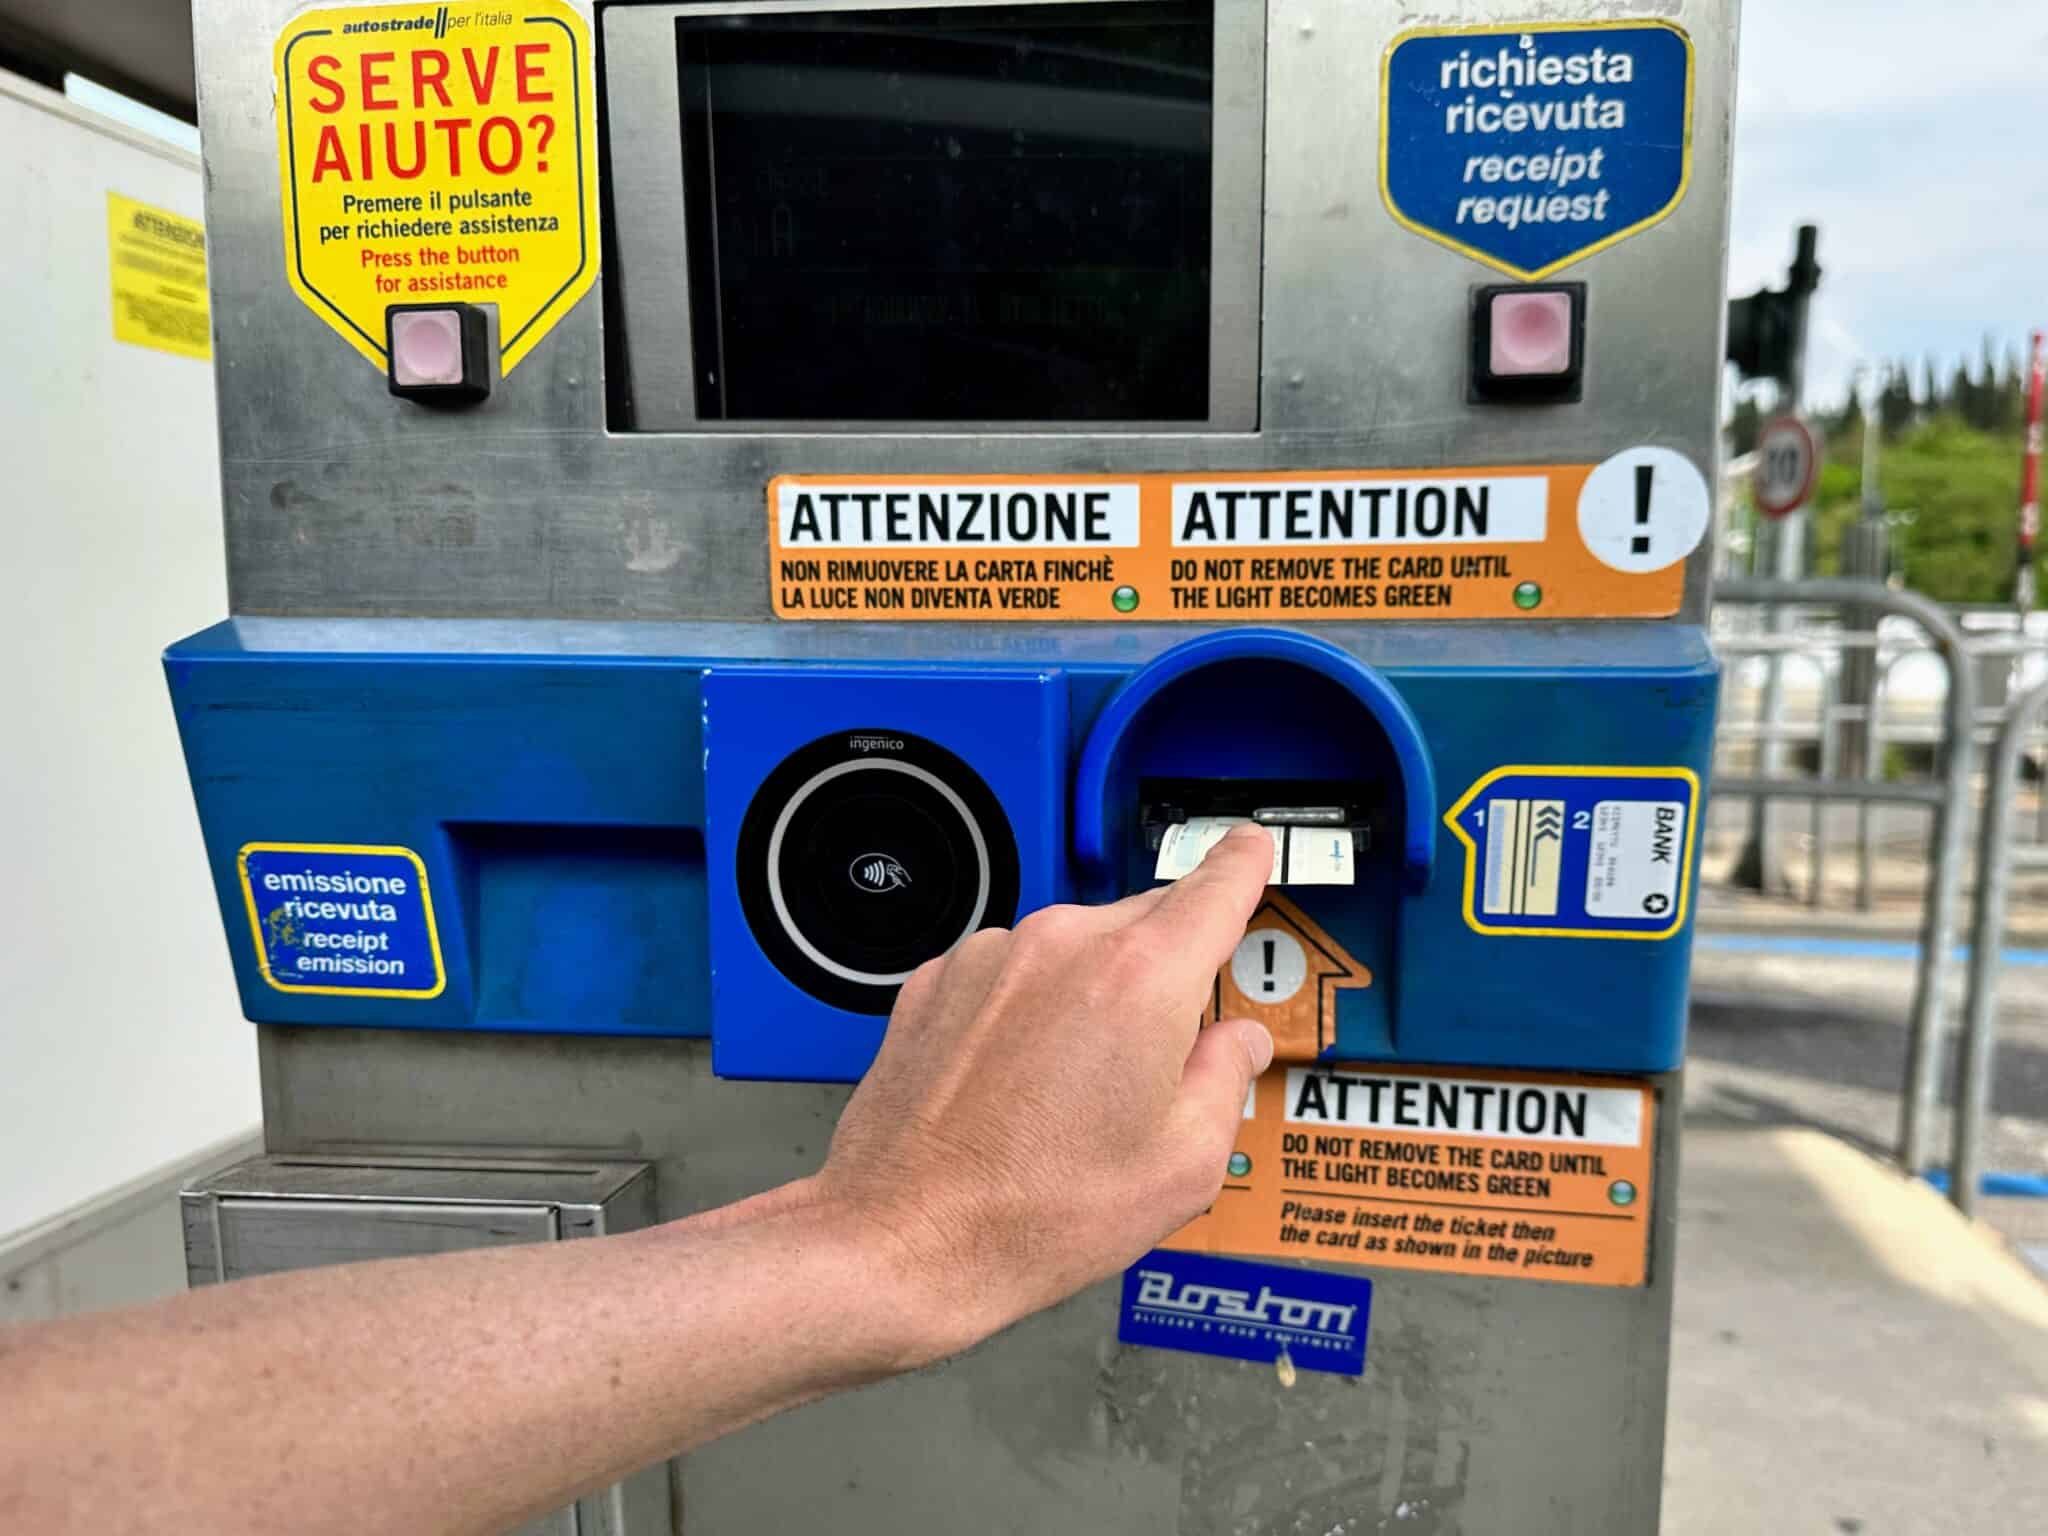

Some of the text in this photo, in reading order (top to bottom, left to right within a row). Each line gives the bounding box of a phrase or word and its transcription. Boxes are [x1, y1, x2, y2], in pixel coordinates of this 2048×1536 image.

[343, 16, 434, 34] autostrade
[447, 14, 471, 32] per
[308, 43, 554, 114] SERVE
[1440, 48, 1633, 88] richiesta
[1446, 94, 1625, 134] ricevuta
[312, 115, 555, 183] AIUTO?
[1463, 147, 1604, 187] receipt
[343, 188, 532, 214] Premere il pulsante
[1455, 189, 1610, 230] request
[320, 215, 558, 244] per richiedere assistenza
[361, 246, 520, 268] Press the button
[376, 271, 507, 293] for assistance
[790, 492, 1111, 541] ATTENZIONE
[1182, 485, 1490, 541] ATTENTION
[1631, 466, 1654, 554] !
[781, 555, 1114, 582] NON RIMUOVERE LA CARTA FINCHÈ
[1171, 555, 1512, 581] DO NOT REMOVE THE CARD UNTIL
[782, 588, 1060, 608] LA LUCE NON DIVENTA VERDE
[1170, 584, 1452, 608] THE LIGHT BECOMES GREEN
[850, 735, 904, 752] ingenico
[1473, 810, 1485, 827] 1
[1572, 811, 1591, 829] 2
[1651, 807, 1676, 864] BANK
[264, 869, 406, 895] emissione
[283, 896, 397, 922] ricevuta
[303, 930, 389, 954] receipt
[297, 954, 405, 975] emission
[1263, 940, 1275, 992] !
[1294, 1074, 1588, 1138] ATTENTION
[1283, 1133, 1607, 1176] DO NOT REMOVE THE CARD UNTIL
[1282, 1158, 1551, 1198] THE LIGHT BECOMES GREEN
[1281, 1201, 1556, 1241] Please insert the ticket then
[1280, 1224, 1593, 1268] the card as shown in the picture
